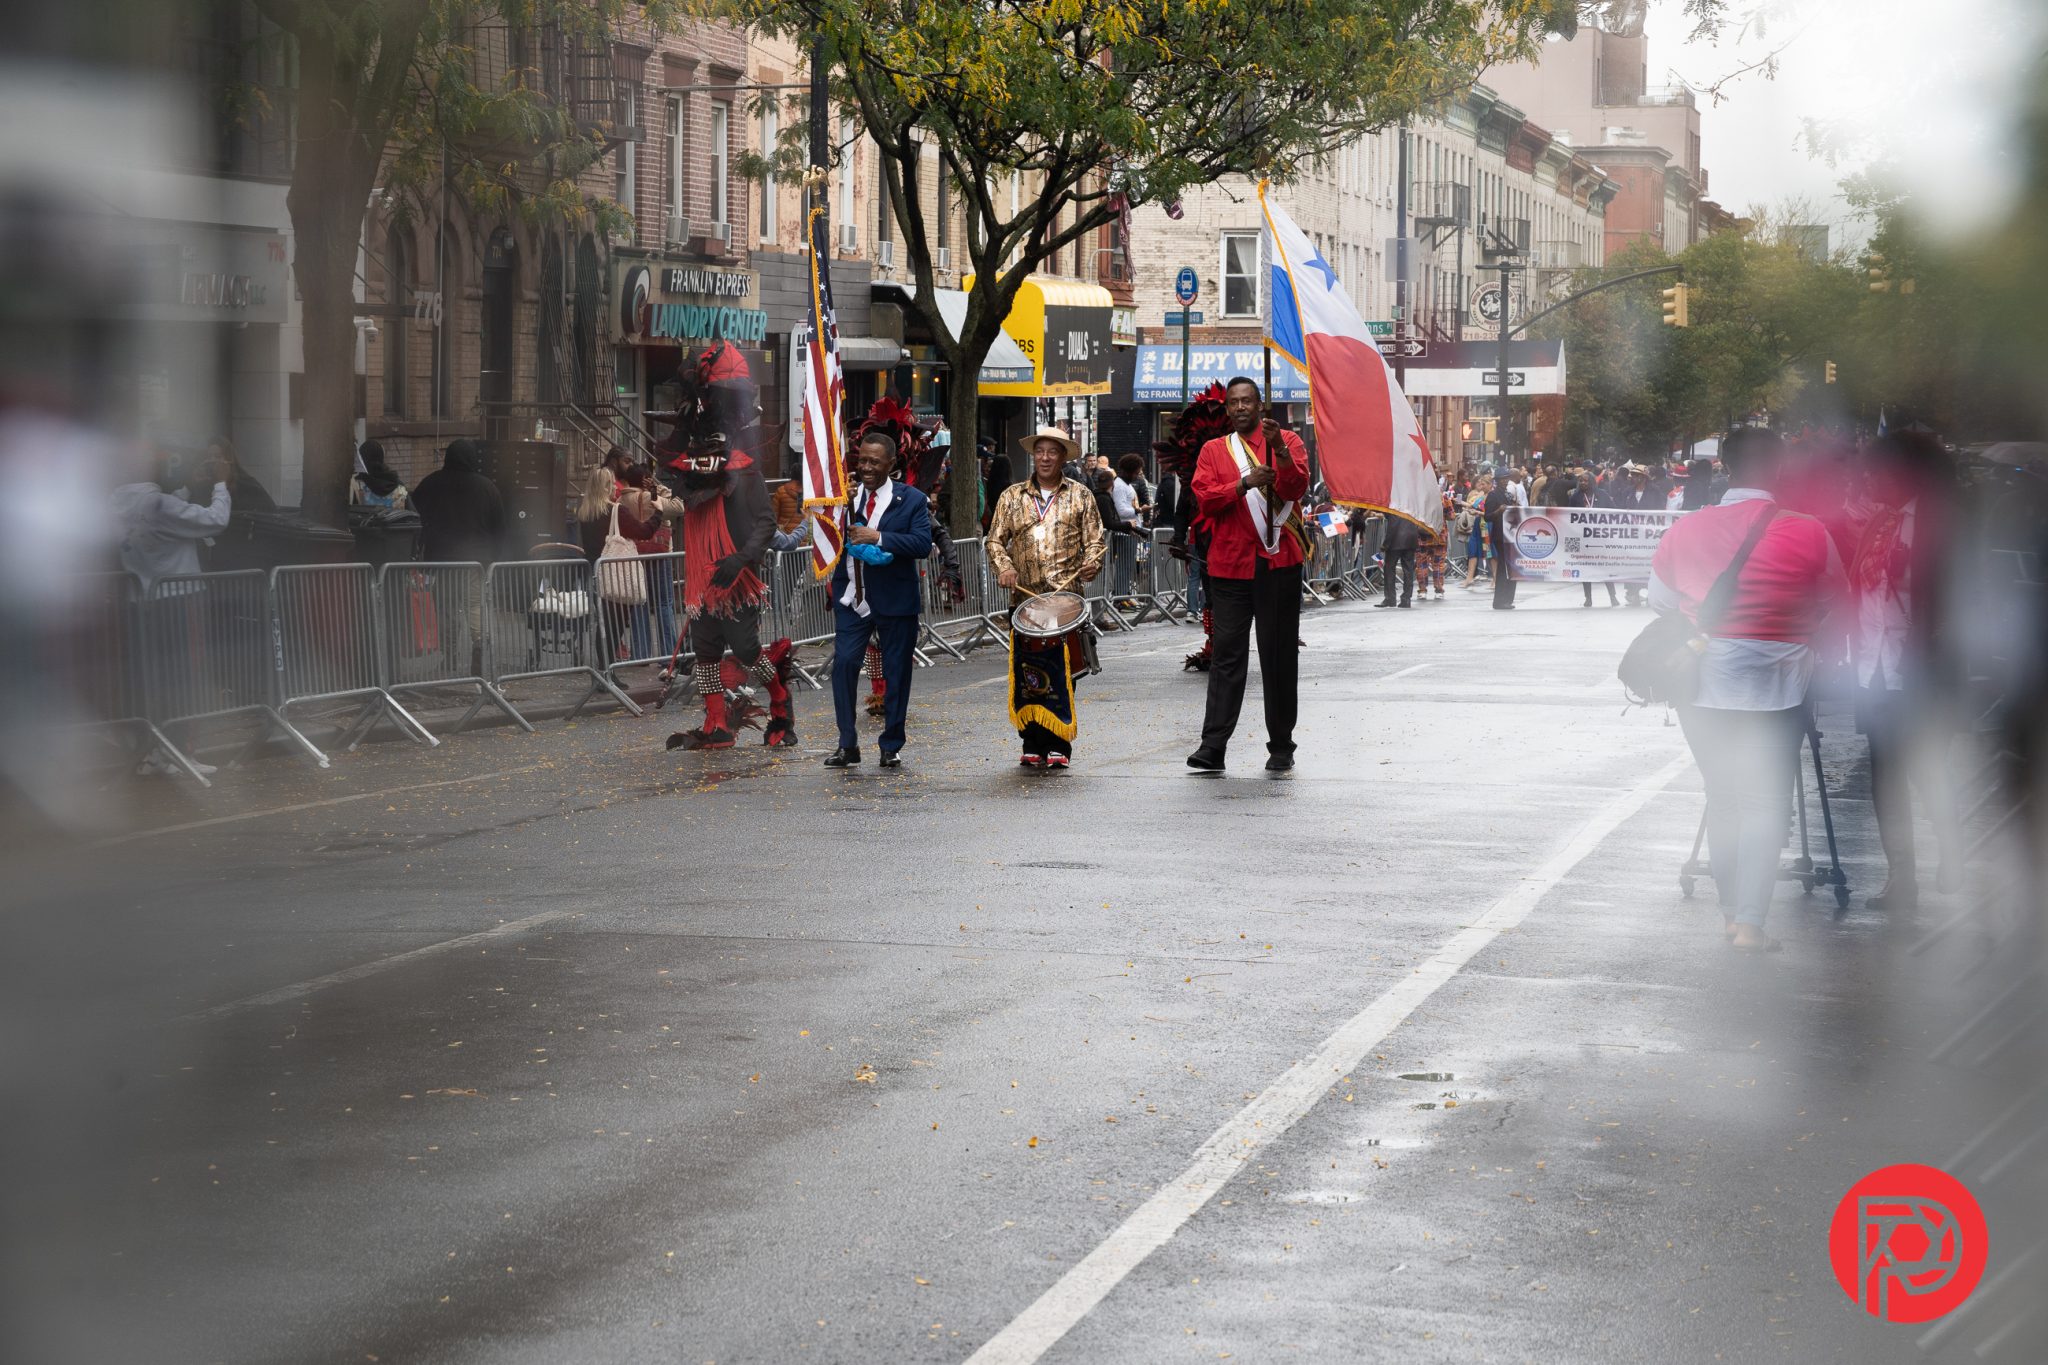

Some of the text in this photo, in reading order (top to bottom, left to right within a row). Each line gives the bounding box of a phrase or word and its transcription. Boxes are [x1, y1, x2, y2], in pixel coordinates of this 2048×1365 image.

[670, 269, 752, 298] FRANKLIN EXPRESS
[414, 290, 443, 327] 776
[651, 303, 768, 341] LAUNDRY CENTER
[1068, 331, 1089, 361] DUALS
[1162, 351, 1281, 371] HAPPY WOK
[1136, 390, 1150, 399] 762
[1151, 390, 1190, 399] FRANKL
[1570, 512, 1666, 526] PANAMANIAN
[1583, 527, 1639, 539] DESFILE
[272, 620, 283, 669] NYPD
